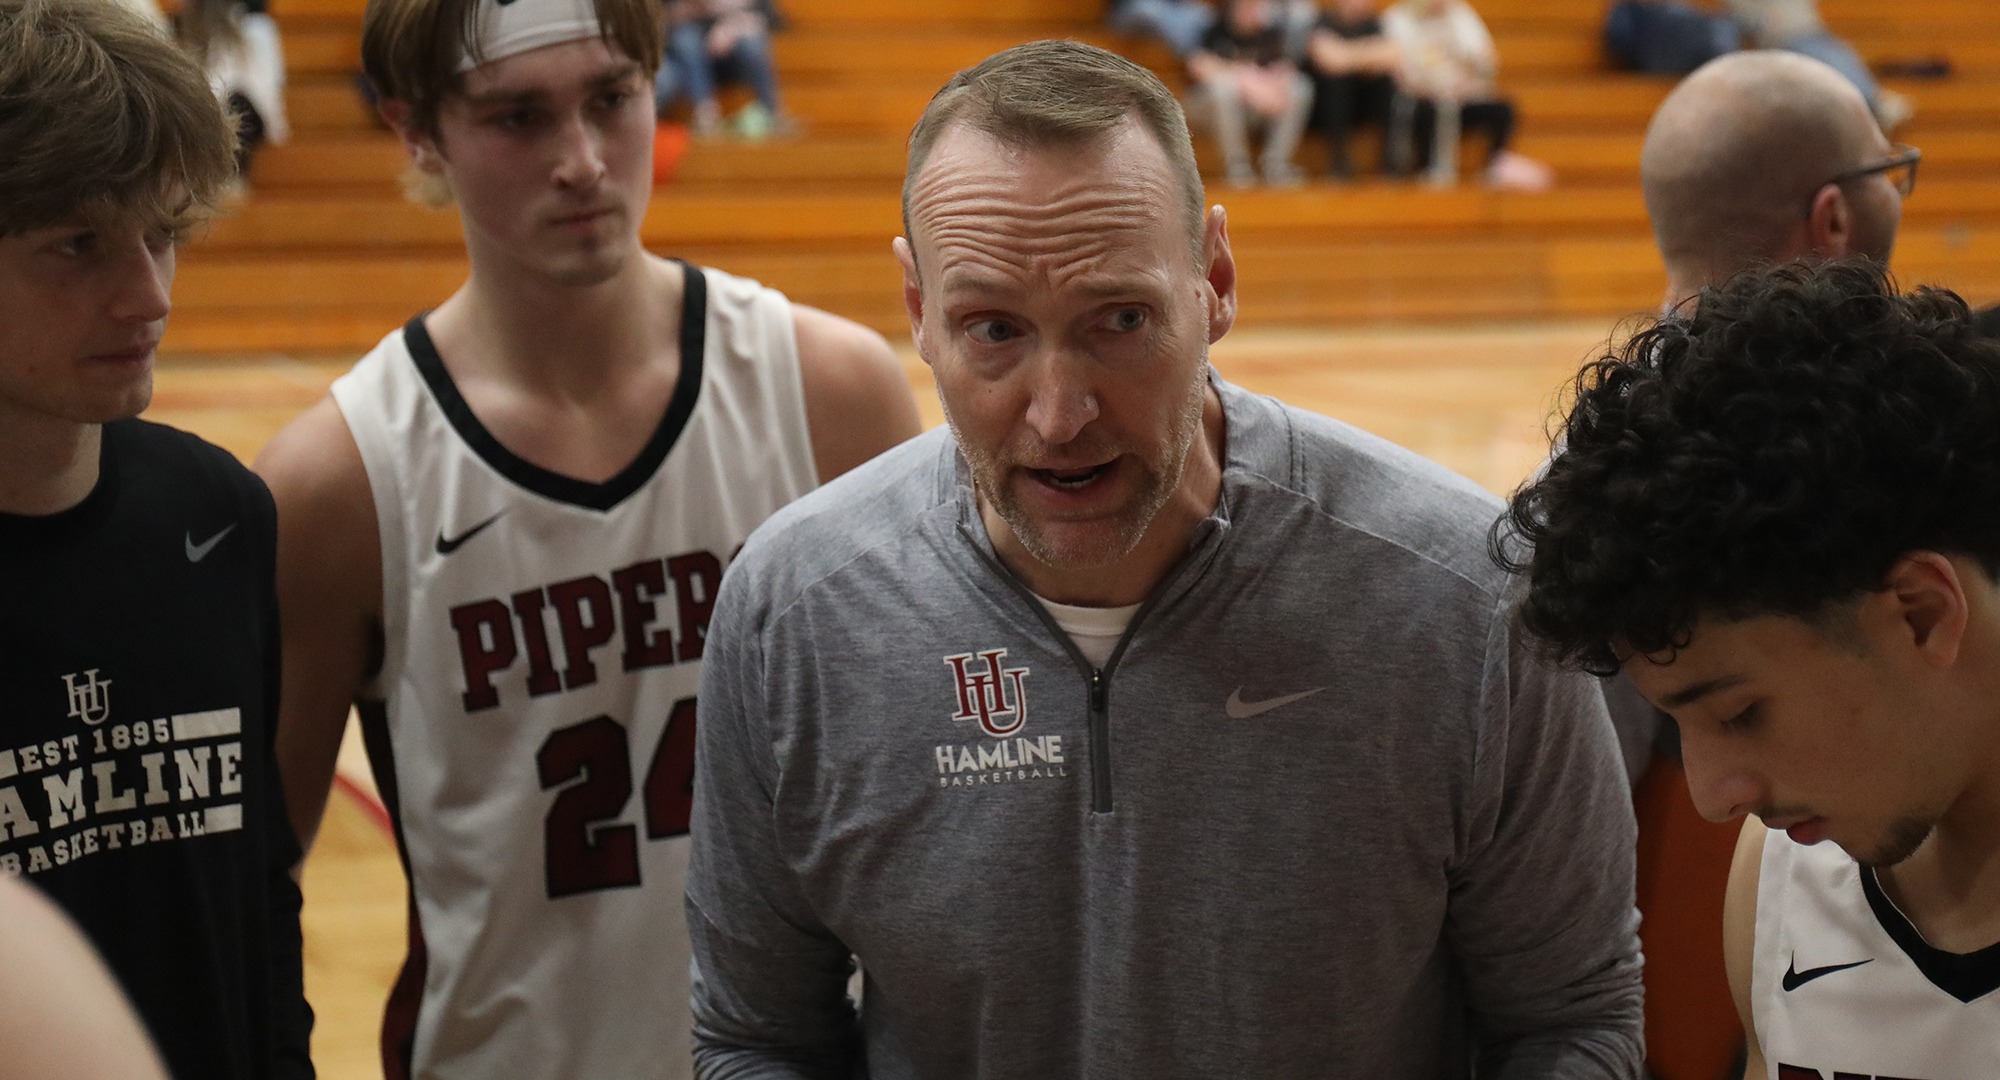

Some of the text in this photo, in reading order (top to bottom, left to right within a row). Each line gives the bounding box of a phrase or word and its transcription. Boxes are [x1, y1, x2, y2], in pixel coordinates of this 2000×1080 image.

[450, 541, 744, 713] PIPER
[61, 668, 112, 725] HU
[943, 647, 1030, 738] HU
[18, 717, 170, 773] EST 1895
[935, 735, 1064, 774] HAMLINE
[0, 742, 242, 842] AMLINE
[940, 767, 1067, 787] BASKETBALL
